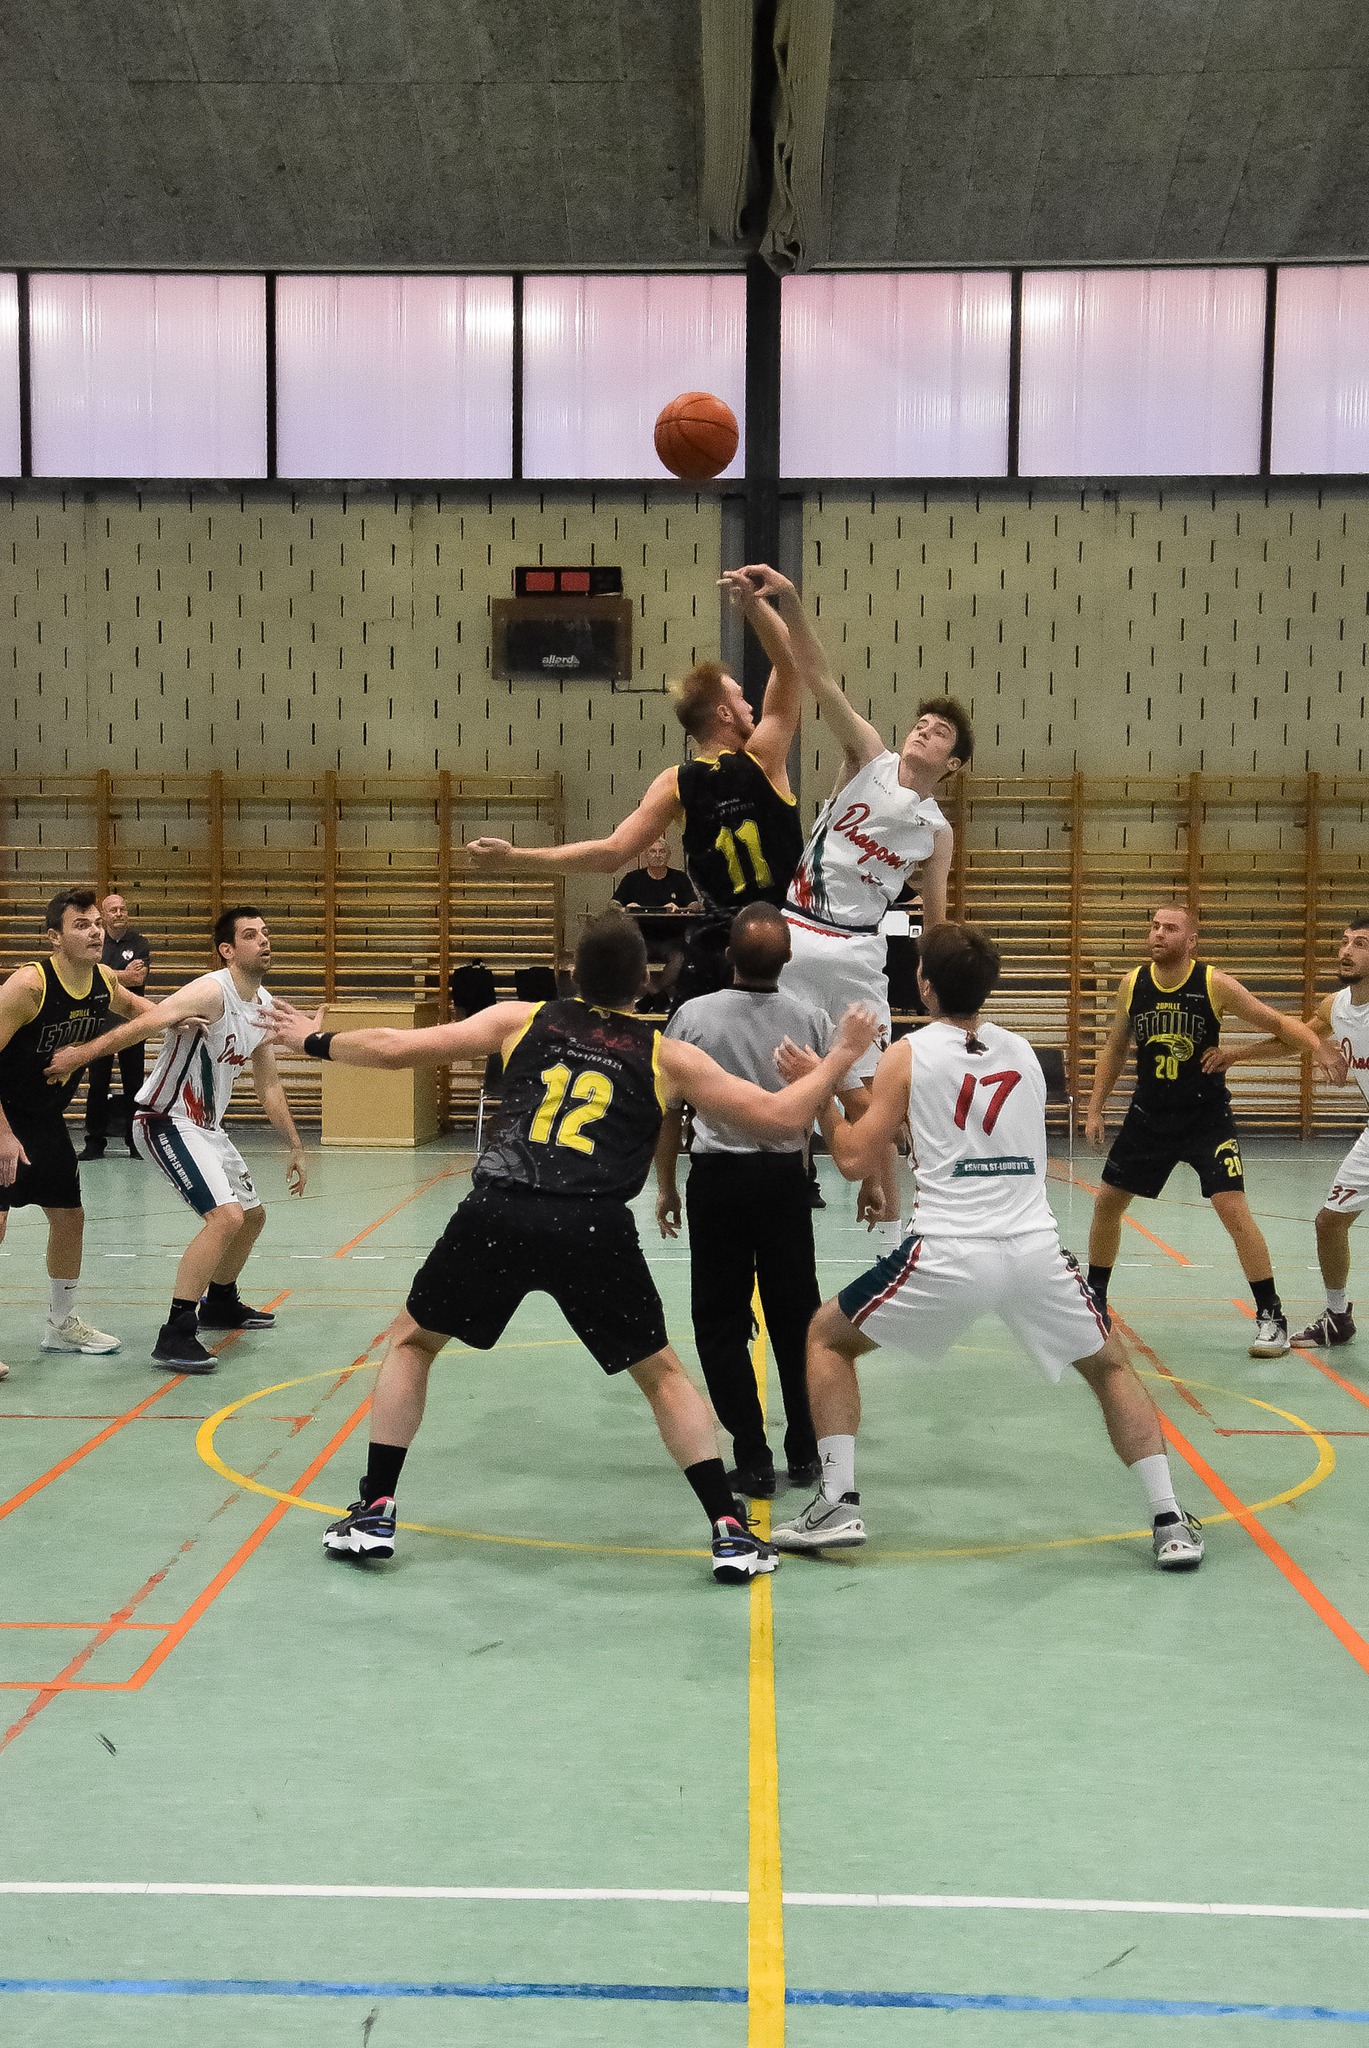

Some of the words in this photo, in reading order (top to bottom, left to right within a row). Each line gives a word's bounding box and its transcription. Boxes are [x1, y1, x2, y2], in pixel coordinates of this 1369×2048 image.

[715, 819, 775, 894] 11
[1134, 1010, 1205, 1043] ETOILE
[1155, 1055, 1179, 1080] 20
[529, 1063, 614, 1155] 12
[954, 1070, 1023, 1136] 17
[1224, 1155, 1243, 1178] 20
[1327, 1185, 1358, 1205] 37
